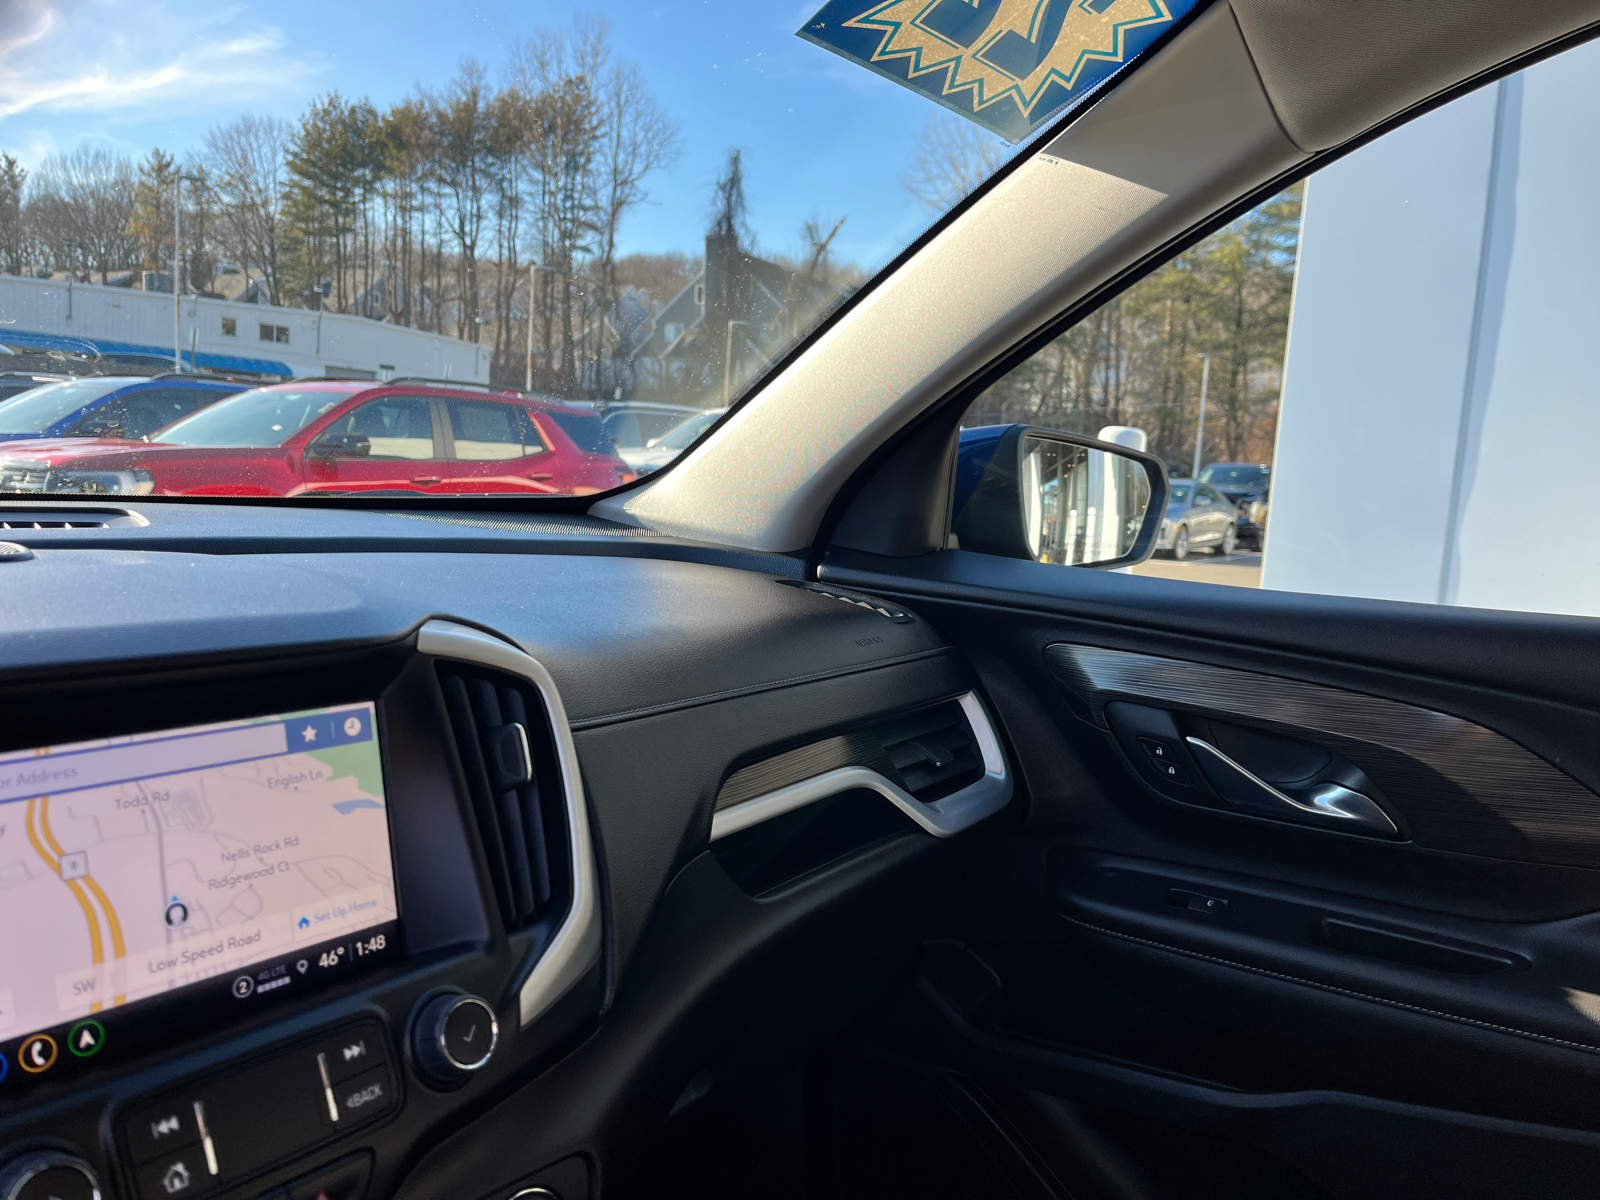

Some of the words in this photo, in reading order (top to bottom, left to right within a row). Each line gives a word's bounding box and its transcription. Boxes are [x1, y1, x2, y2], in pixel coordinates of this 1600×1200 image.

[16, 768, 79, 786] Address
[266, 772, 308, 789] English
[309, 769, 323, 781] Ln
[115, 794, 149, 810] Todd
[152, 790, 170, 802] Rd
[220, 847, 251, 863] Nells
[253, 840, 282, 855] Rock
[283, 836, 299, 849] Rd
[208, 864, 275, 890] Ridgewood
[276, 861, 291, 873] Ct
[313, 910, 331, 924] Set
[333, 906, 348, 919] Up
[348, 899, 378, 912] Home
[147, 956, 178, 974] Low
[181, 942, 224, 964] Speed
[227, 929, 262, 949] Road
[355, 934, 386, 956] 1:48
[318, 946, 345, 968] 46°
[257, 970, 271, 981] 4G
[271, 965, 287, 977] LTE
[72, 977, 96, 996] SW
[238, 981, 248, 994] 2
[353, 1083, 384, 1106] BACK
